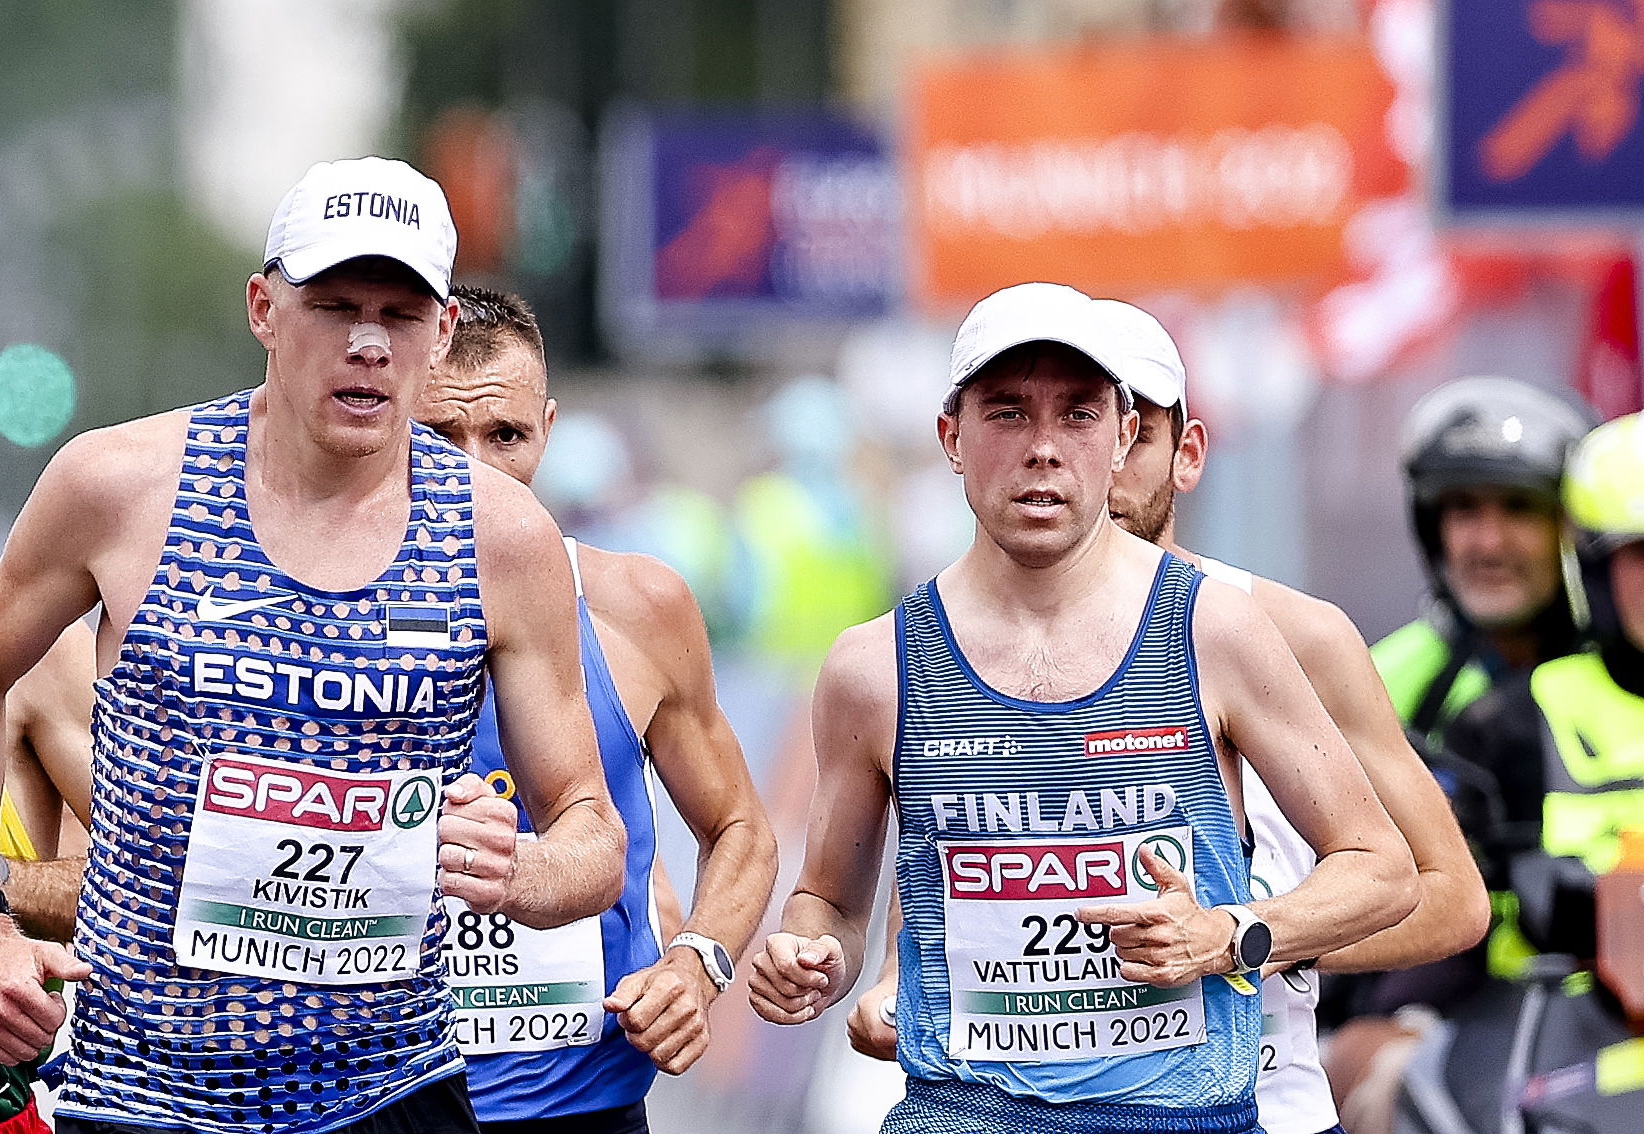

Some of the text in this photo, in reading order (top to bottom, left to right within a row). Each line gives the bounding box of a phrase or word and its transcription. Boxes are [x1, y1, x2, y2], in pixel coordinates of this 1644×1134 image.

[323, 192, 421, 230] ESTONIA
[192, 652, 435, 713] ESTONIA
[923, 737, 1001, 757] CRAFT
[1088, 730, 1185, 754] motonet
[209, 766, 385, 824] SPAR
[930, 783, 1177, 832] FINLAND
[271, 839, 365, 885] 227
[951, 849, 1122, 893] SPAR
[252, 878, 372, 909] KIVISTIK
[240, 909, 246, 926] I
[253, 911, 299, 934] RUN
[1021, 913, 1111, 957] 229
[191, 929, 406, 975] MUNICH 2022
[444, 954, 519, 977] URIS
[972, 956, 1122, 983] VATTULAIN
[1005, 995, 1010, 1012] I
[1016, 993, 1060, 1012] RUN
[509, 1012, 588, 1041] 2022
[967, 1009, 1190, 1051] MUNICH 2022
